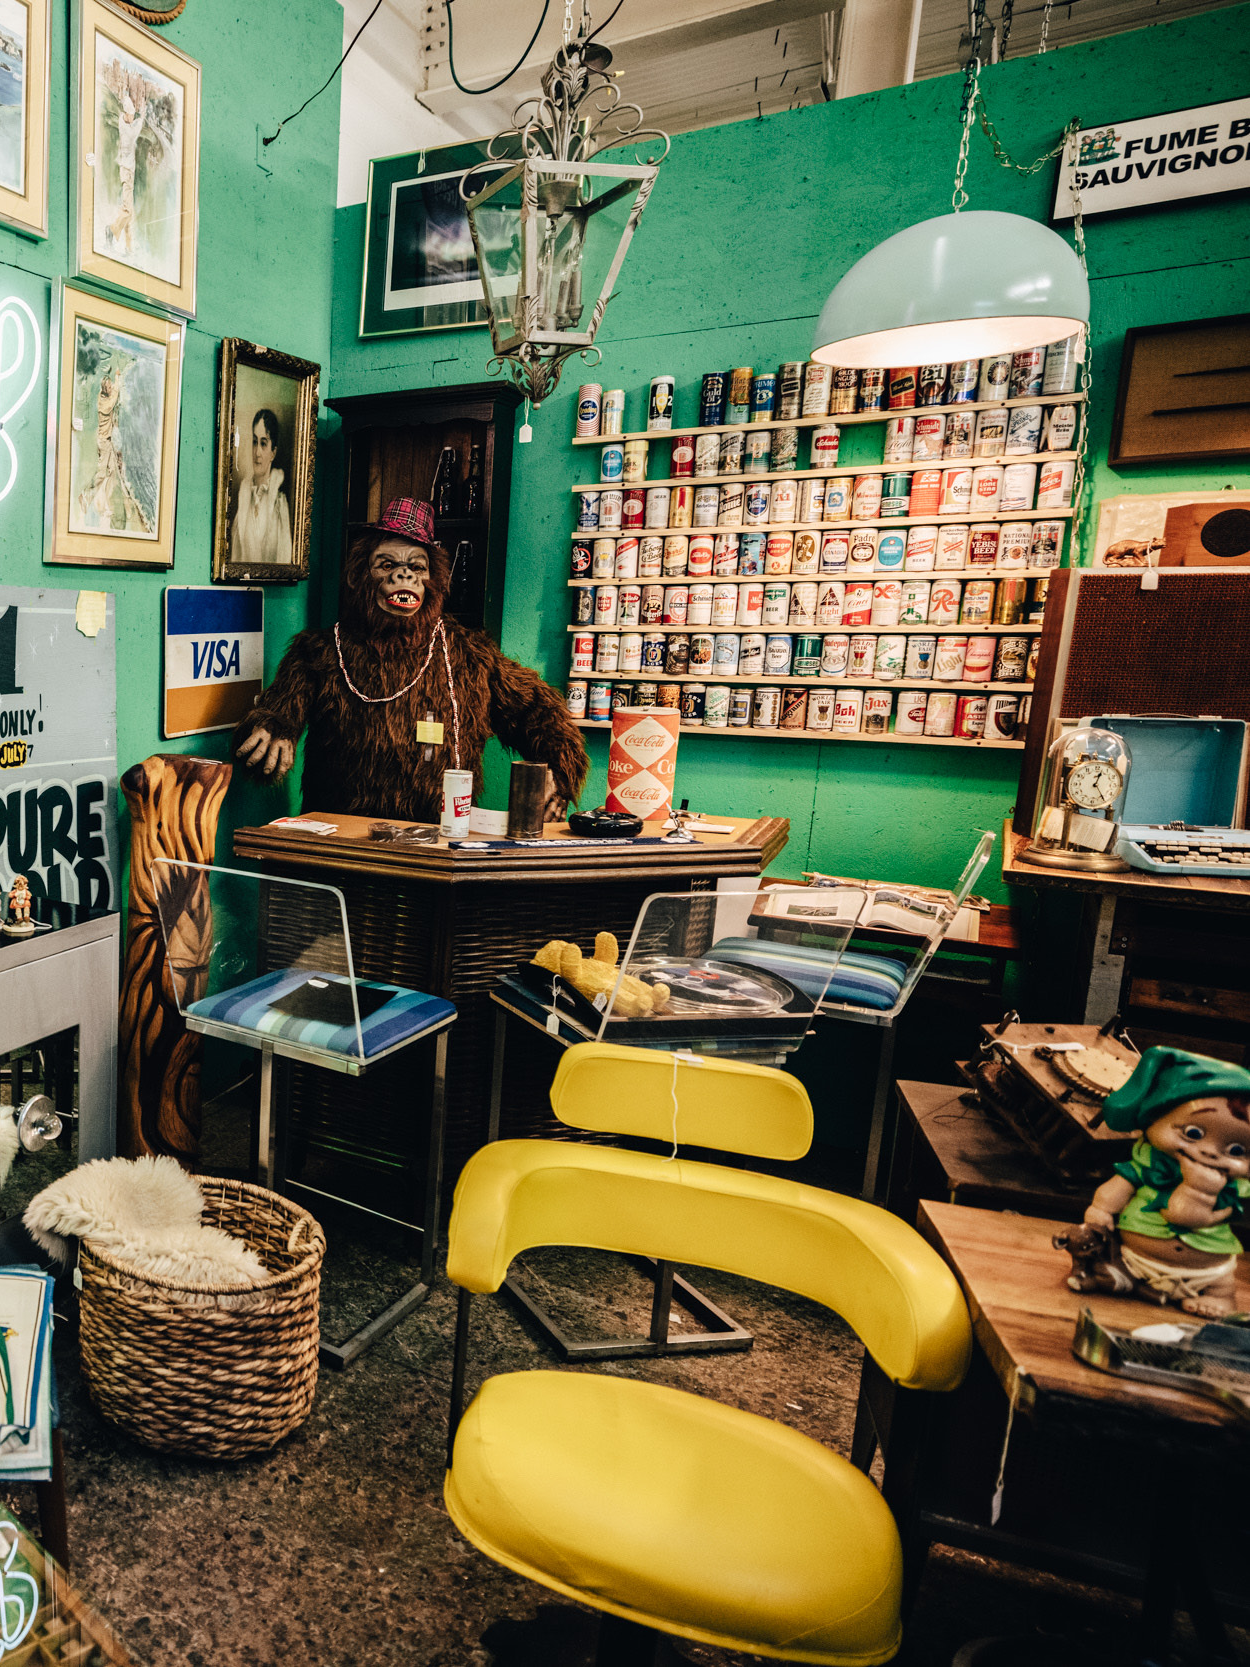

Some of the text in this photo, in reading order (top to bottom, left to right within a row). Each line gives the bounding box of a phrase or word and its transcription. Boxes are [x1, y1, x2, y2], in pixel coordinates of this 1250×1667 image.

[1124, 124, 1219, 159] FUME
[921, 368, 945, 381] 21
[916, 421, 941, 434] Schmidt
[980, 480, 997, 488] LONE
[854, 534, 875, 543] Padre
[819, 606, 839, 617] Light
[190, 639, 241, 679] VISA
[936, 654, 963, 672] Light
[865, 697, 887, 711] Jax
[0, 694, 44, 739] ONLY!
[0, 744, 26, 764] JULY
[27, 744, 34, 758] 7
[609, 760, 633, 774] oke
